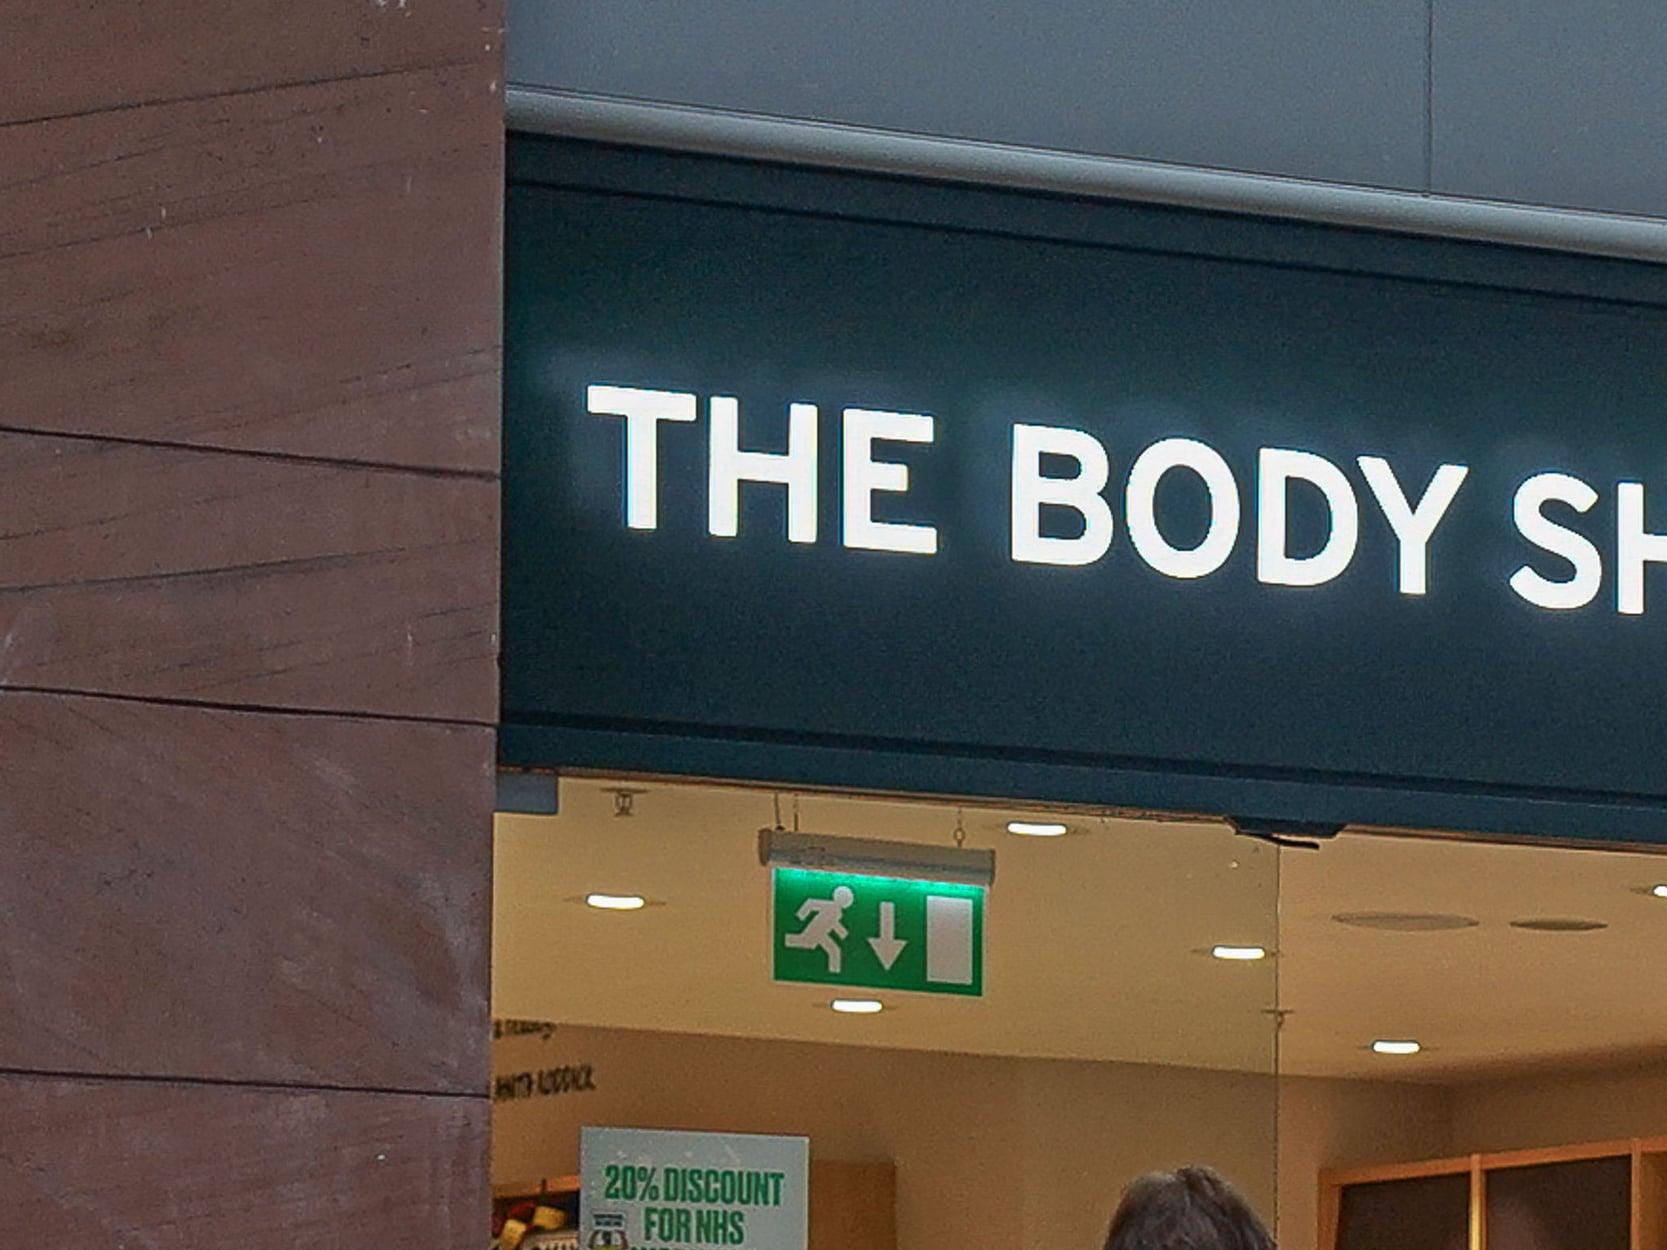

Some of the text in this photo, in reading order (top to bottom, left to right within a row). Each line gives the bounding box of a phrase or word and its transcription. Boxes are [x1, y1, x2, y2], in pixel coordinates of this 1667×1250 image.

[586, 383, 938, 554] THE
[1010, 422, 1470, 597] BODY
[604, 1165, 786, 1206] 20% DISCOUNT
[643, 1207, 744, 1245] FOR NHS
